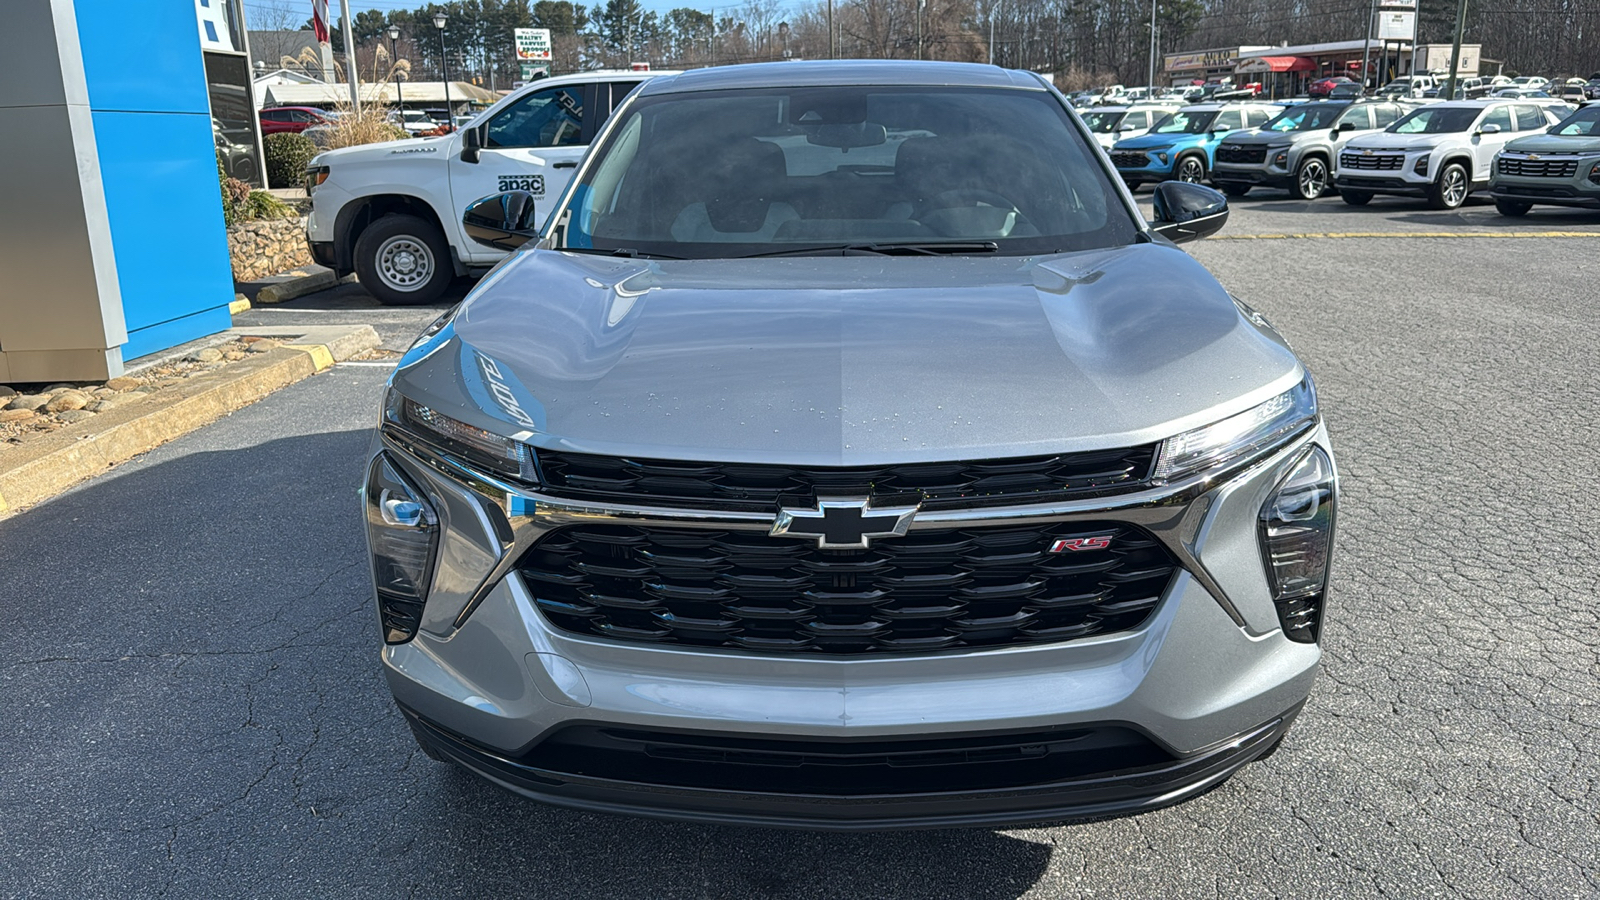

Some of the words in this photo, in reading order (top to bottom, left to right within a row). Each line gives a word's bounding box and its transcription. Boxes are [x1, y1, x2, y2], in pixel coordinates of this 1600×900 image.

[1204, 50, 1231, 60] AUTO
[1202, 58, 1230, 67] MART
[498, 179, 541, 192] apac
[1049, 536, 1113, 552] RS
